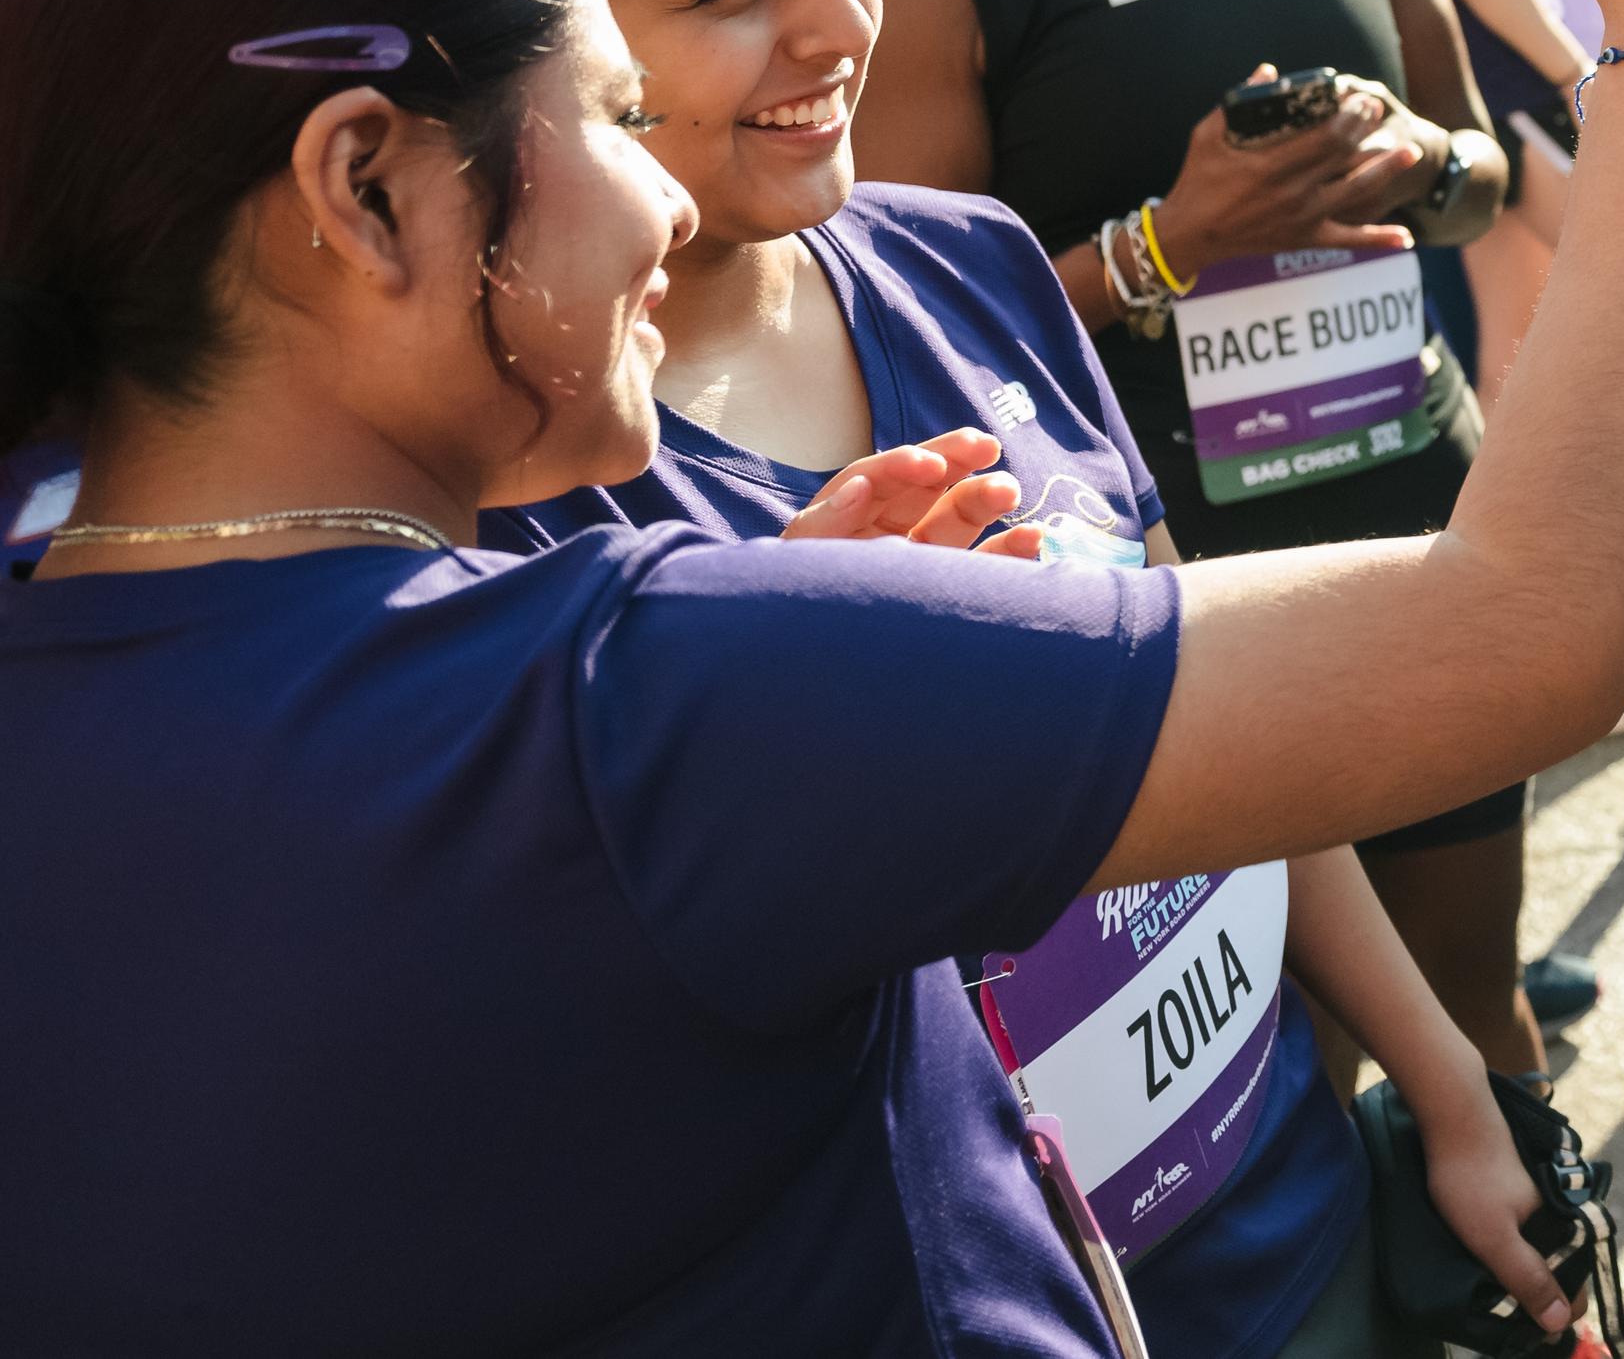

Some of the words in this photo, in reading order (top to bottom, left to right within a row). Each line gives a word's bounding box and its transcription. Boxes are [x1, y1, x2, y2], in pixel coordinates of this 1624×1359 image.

[1187, 315, 1298, 376] RACE
[1308, 286, 1420, 351] BUDDY
[1241, 458, 1292, 487] BAG
[1291, 440, 1363, 475] CHECK
[1127, 911, 1145, 930] FOR
[1142, 896, 1158, 917] THE
[1130, 873, 1209, 953] FUTURE
[1137, 943, 1154, 961] NEW
[1152, 926, 1171, 946] YORK
[1169, 908, 1187, 929] ROAD
[1184, 881, 1212, 911] RUNNERS
[1126, 928, 1253, 1103] ZOILA
